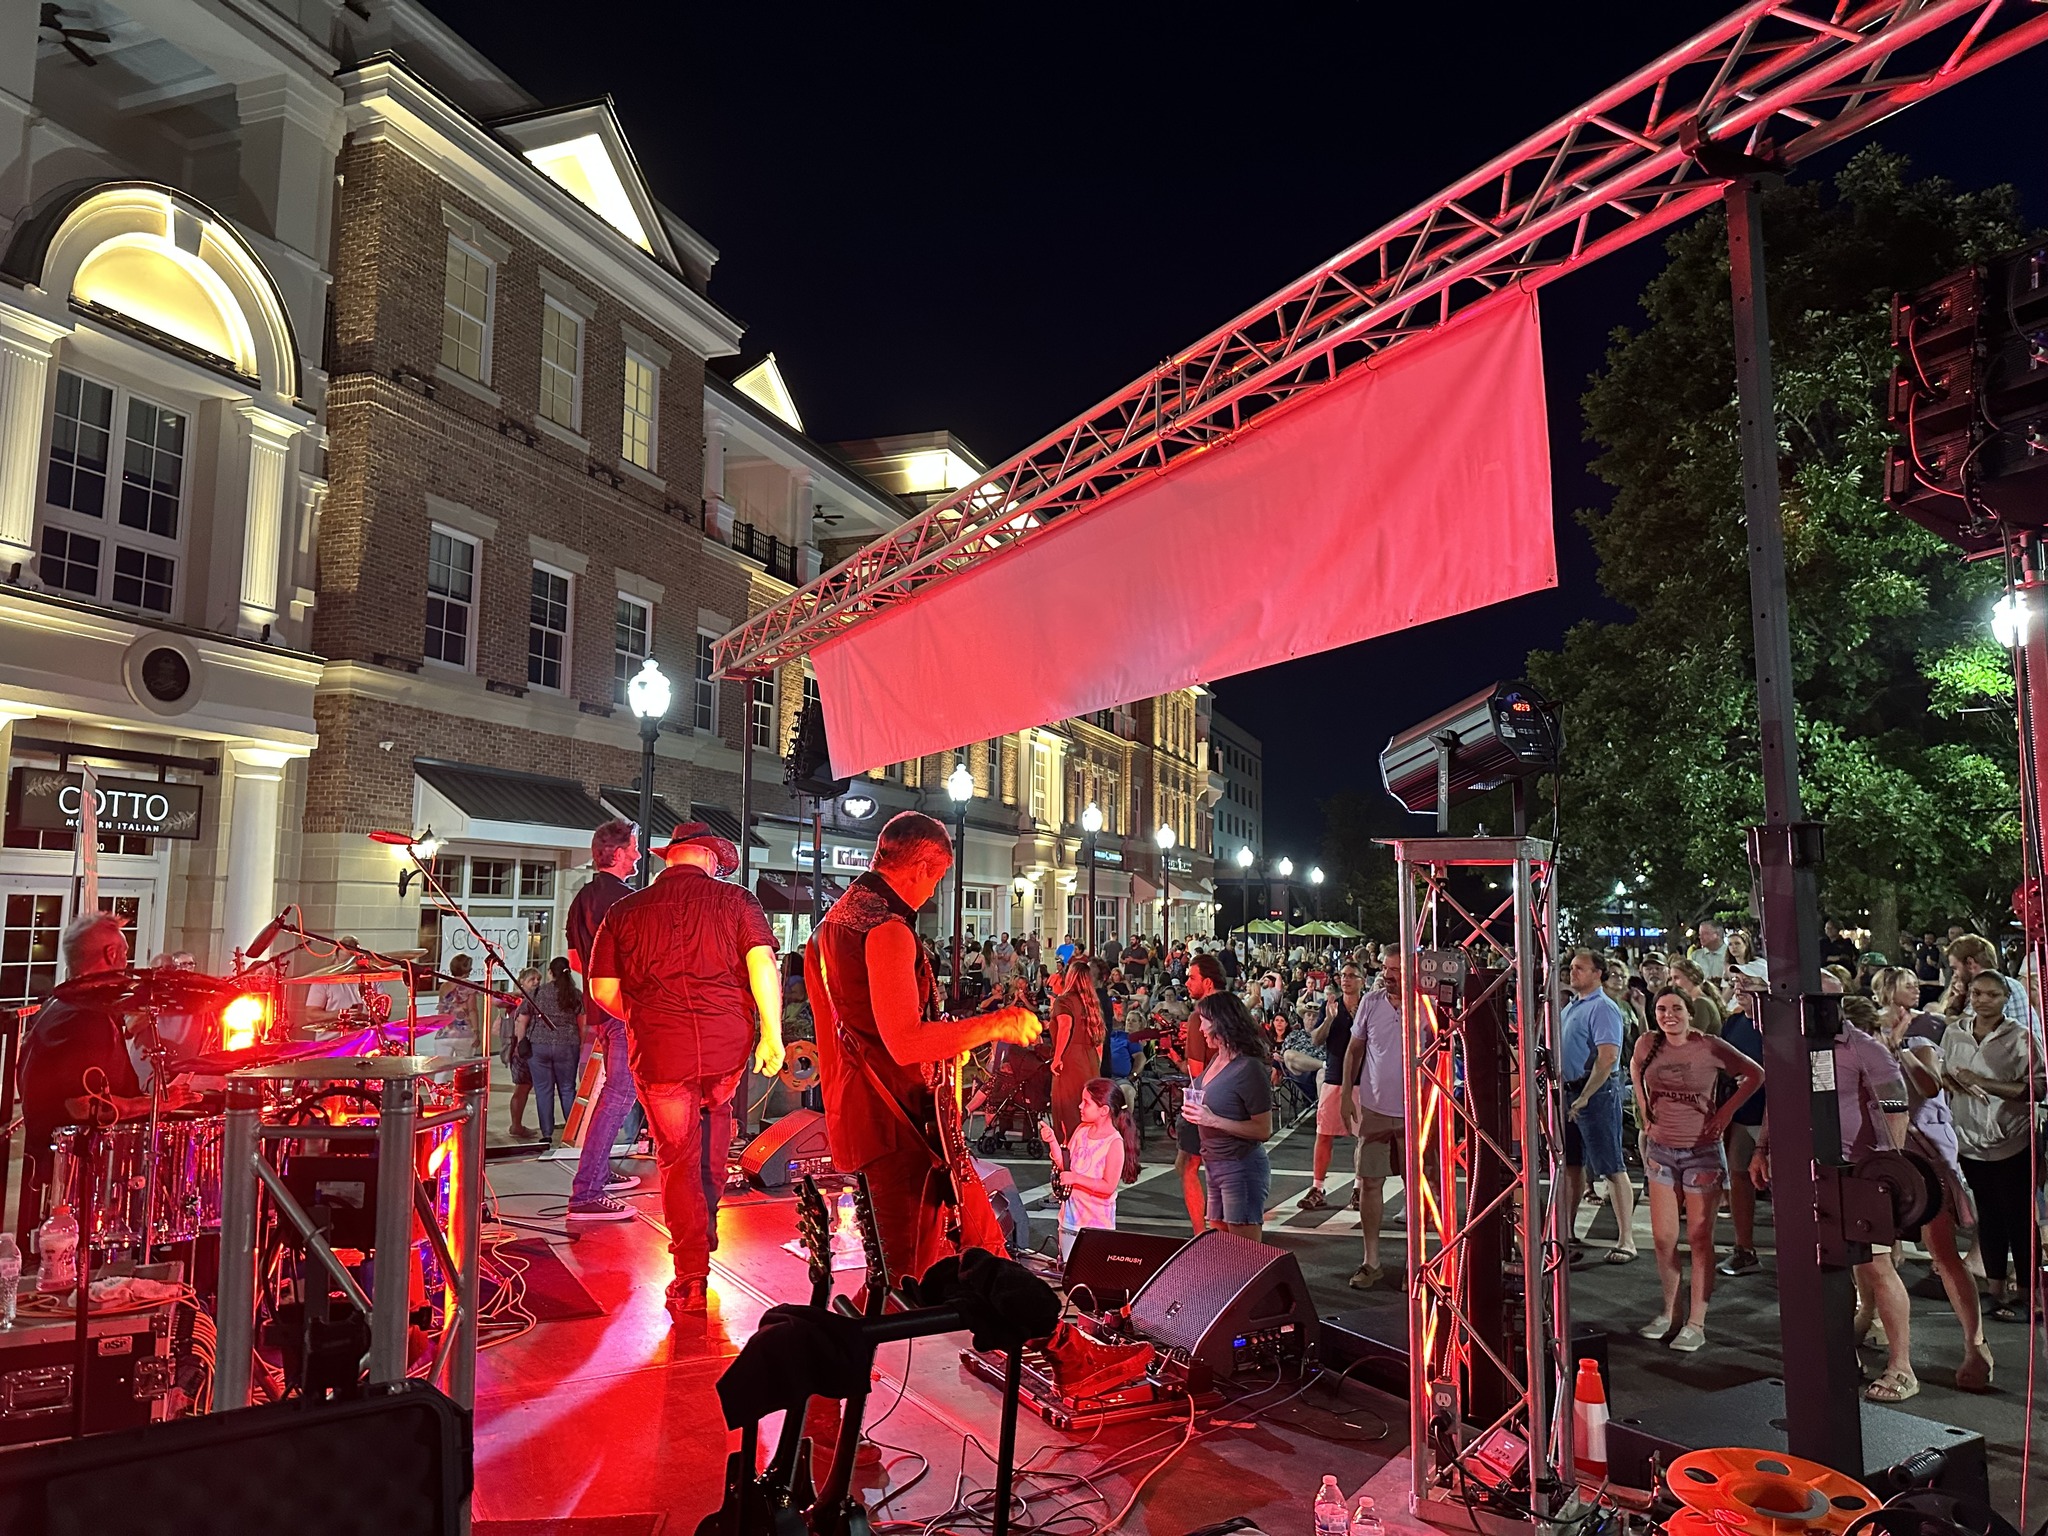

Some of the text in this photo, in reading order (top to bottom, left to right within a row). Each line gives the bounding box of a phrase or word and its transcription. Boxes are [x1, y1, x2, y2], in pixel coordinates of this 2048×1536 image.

[117, 822, 160, 832] ITALIAN
[837, 849, 870, 867] Kilwin
[452, 928, 520, 951] COTTO
[1678, 1093, 1700, 1104] THAT
[1106, 1254, 1143, 1266] HEADRUSH
